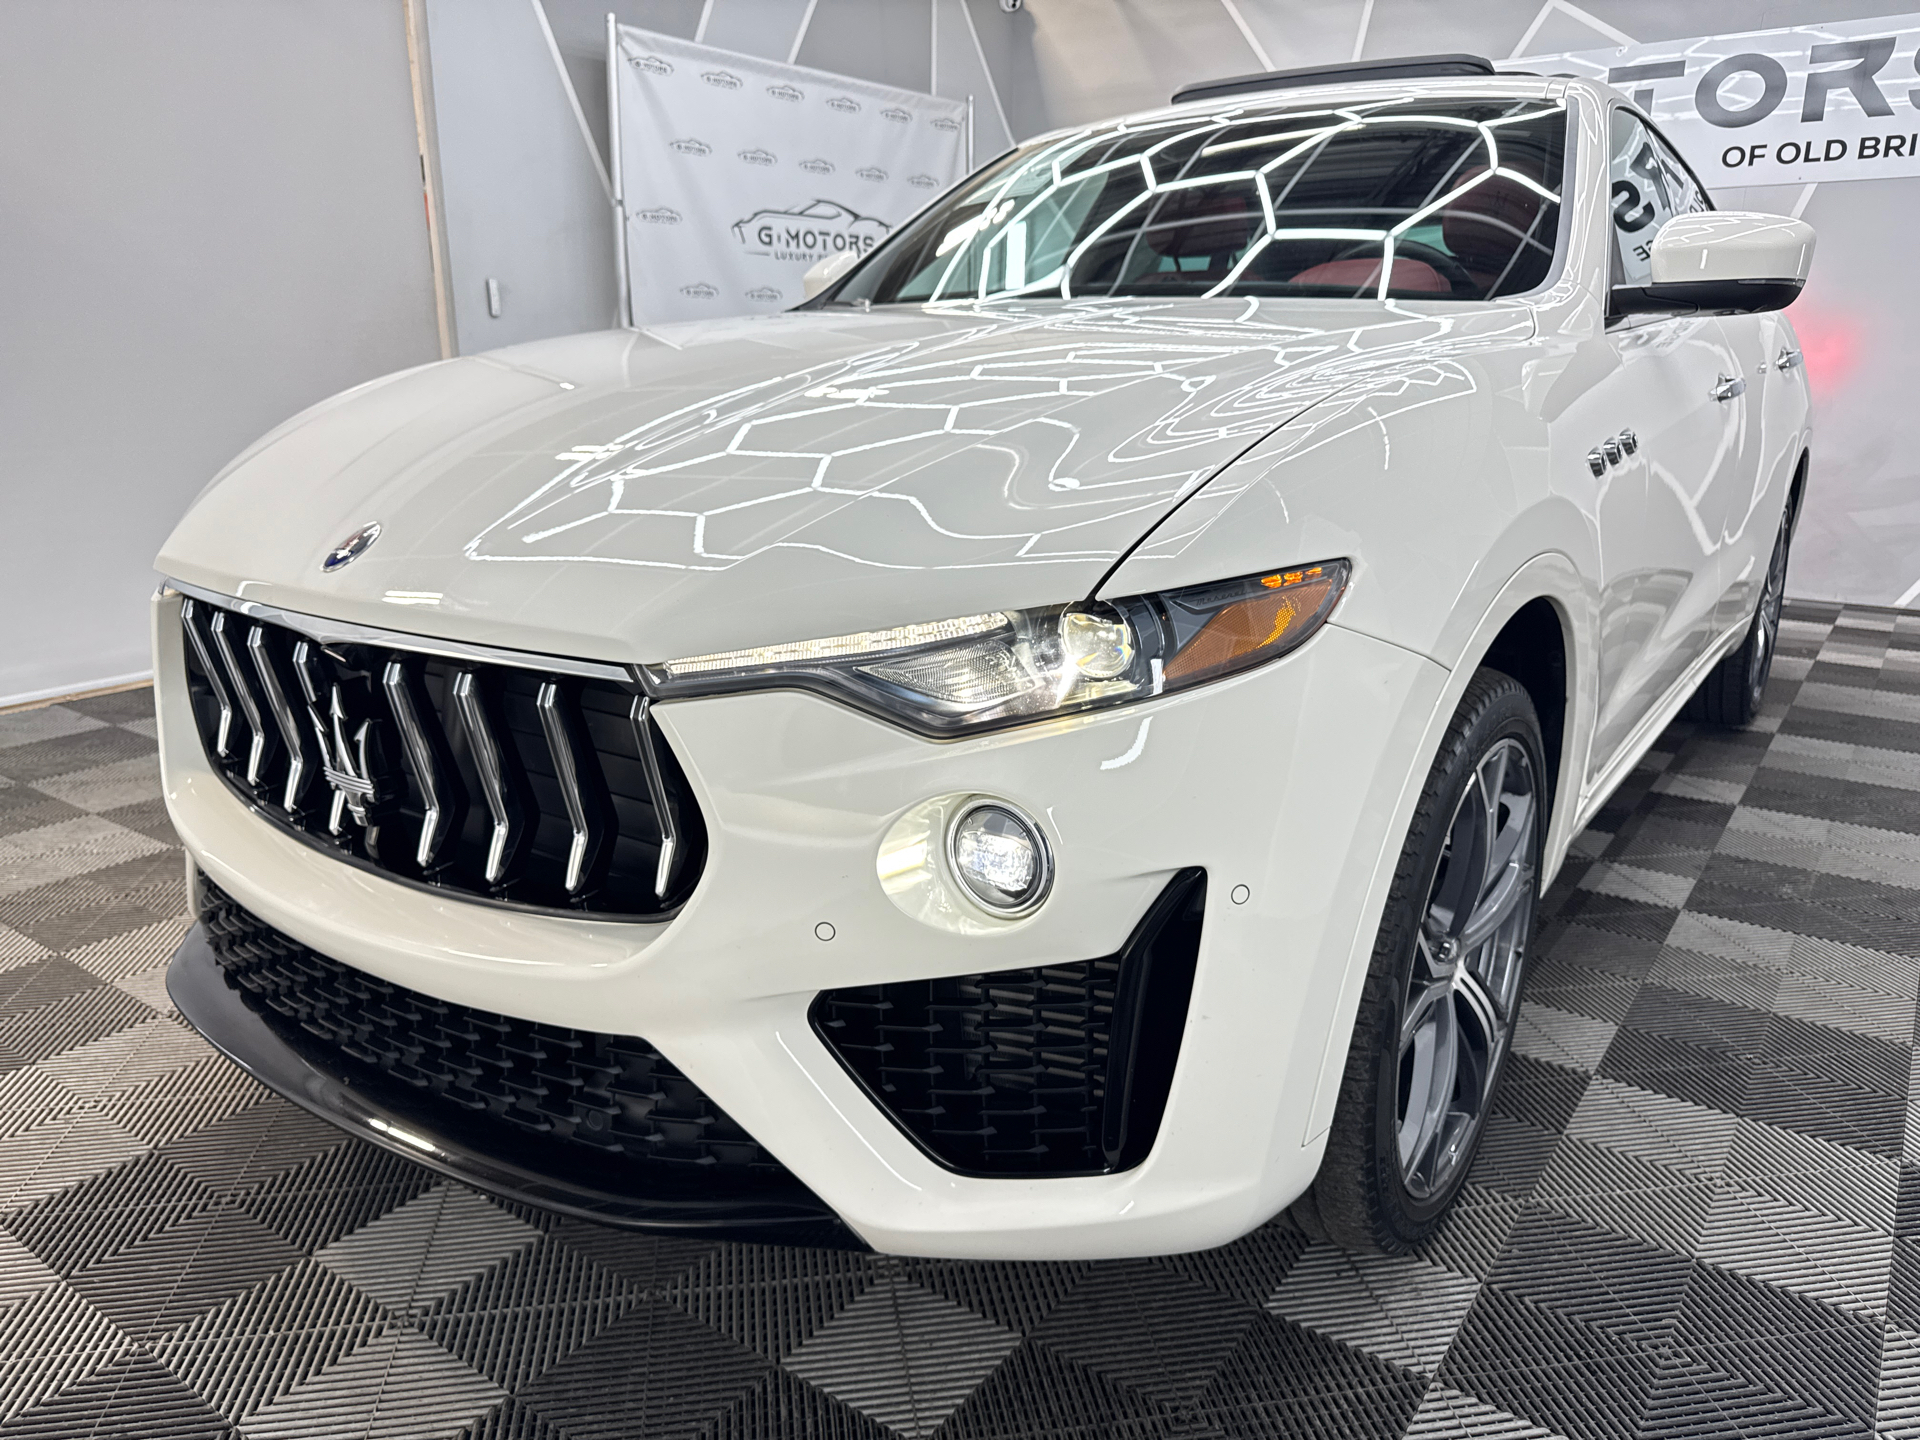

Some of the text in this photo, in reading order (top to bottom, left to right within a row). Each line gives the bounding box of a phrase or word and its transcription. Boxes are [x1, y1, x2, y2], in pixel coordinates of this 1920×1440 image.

[1608, 36, 1920, 128] TOR
[1721, 144, 1768, 168] OF
[1776, 139, 1848, 165] OLD
